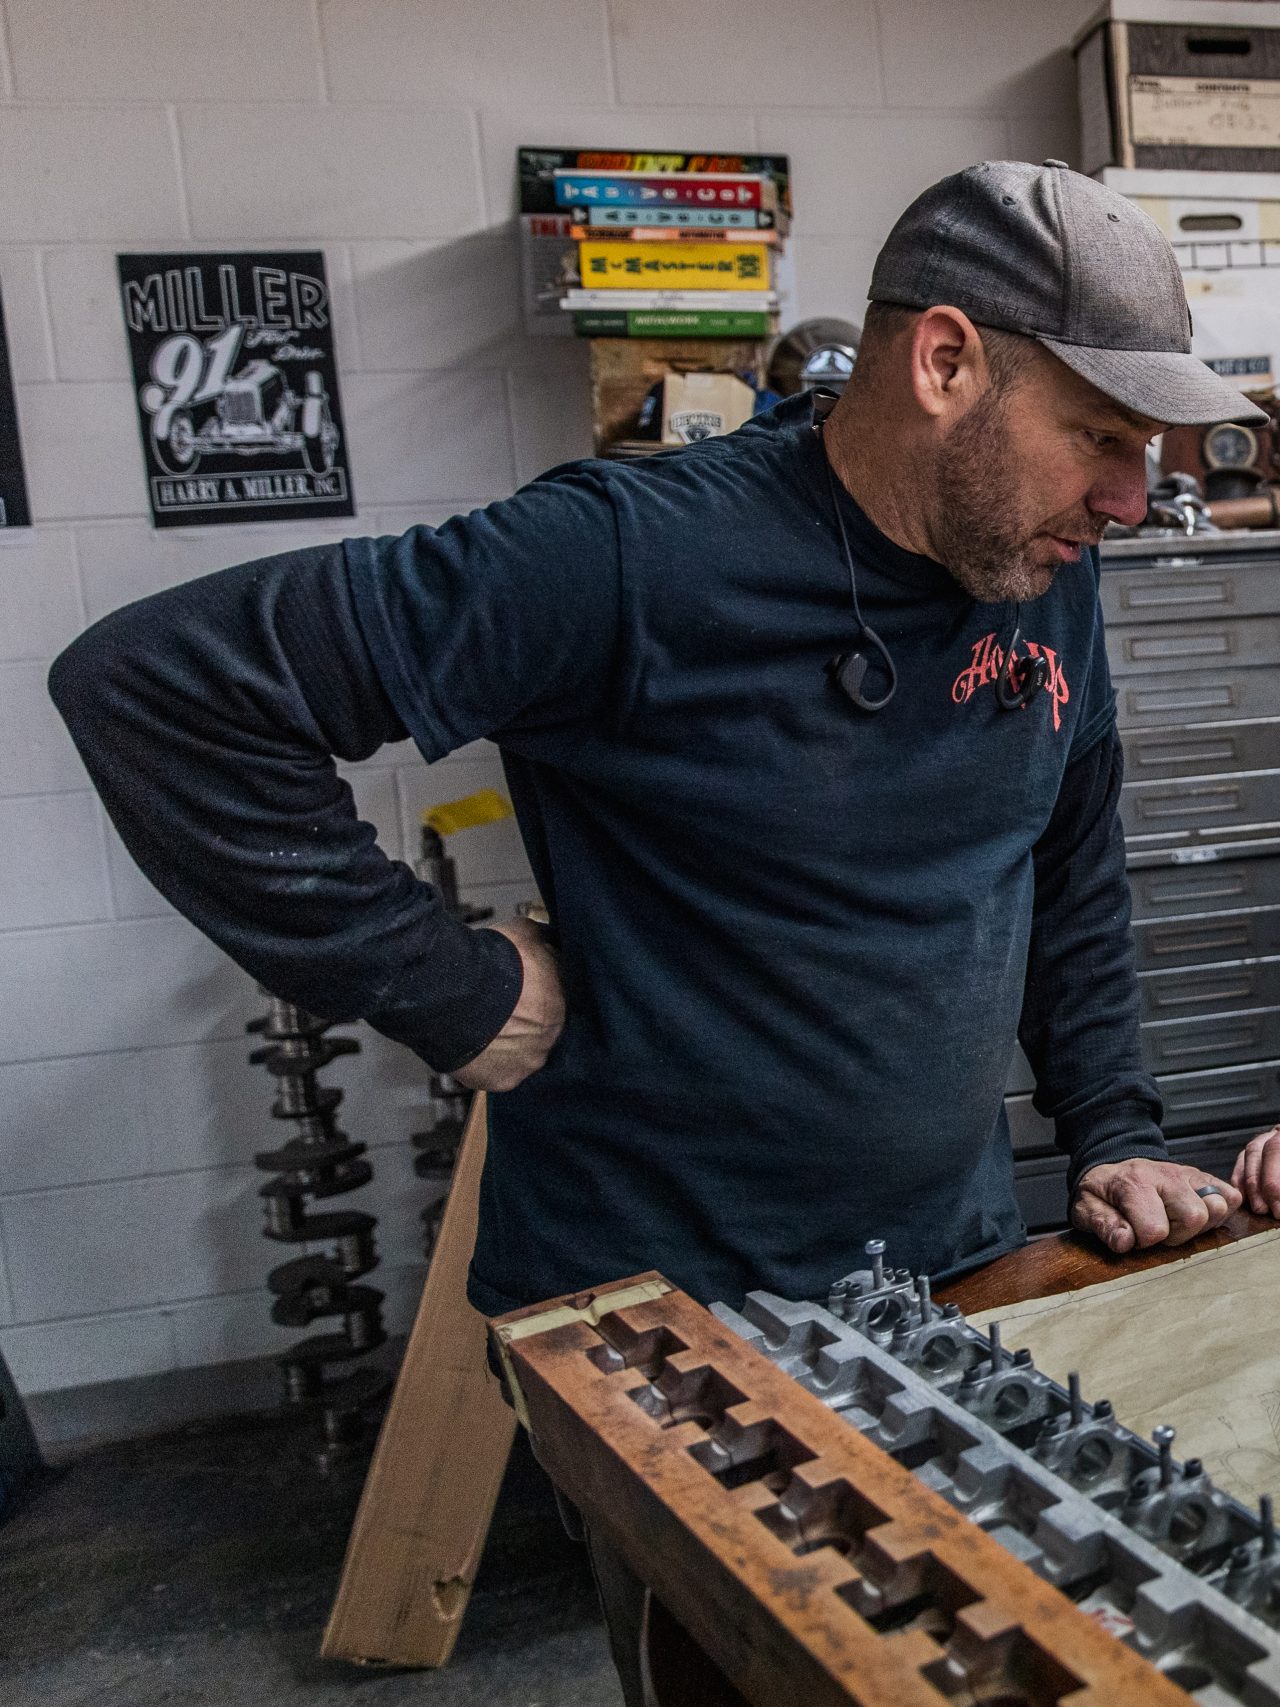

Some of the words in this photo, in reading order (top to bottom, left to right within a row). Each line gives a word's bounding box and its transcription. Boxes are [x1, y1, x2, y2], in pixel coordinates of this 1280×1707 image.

[124, 264, 329, 332] MILLER
[140, 322, 245, 442] 91
[160, 480, 219, 503] HARRY
